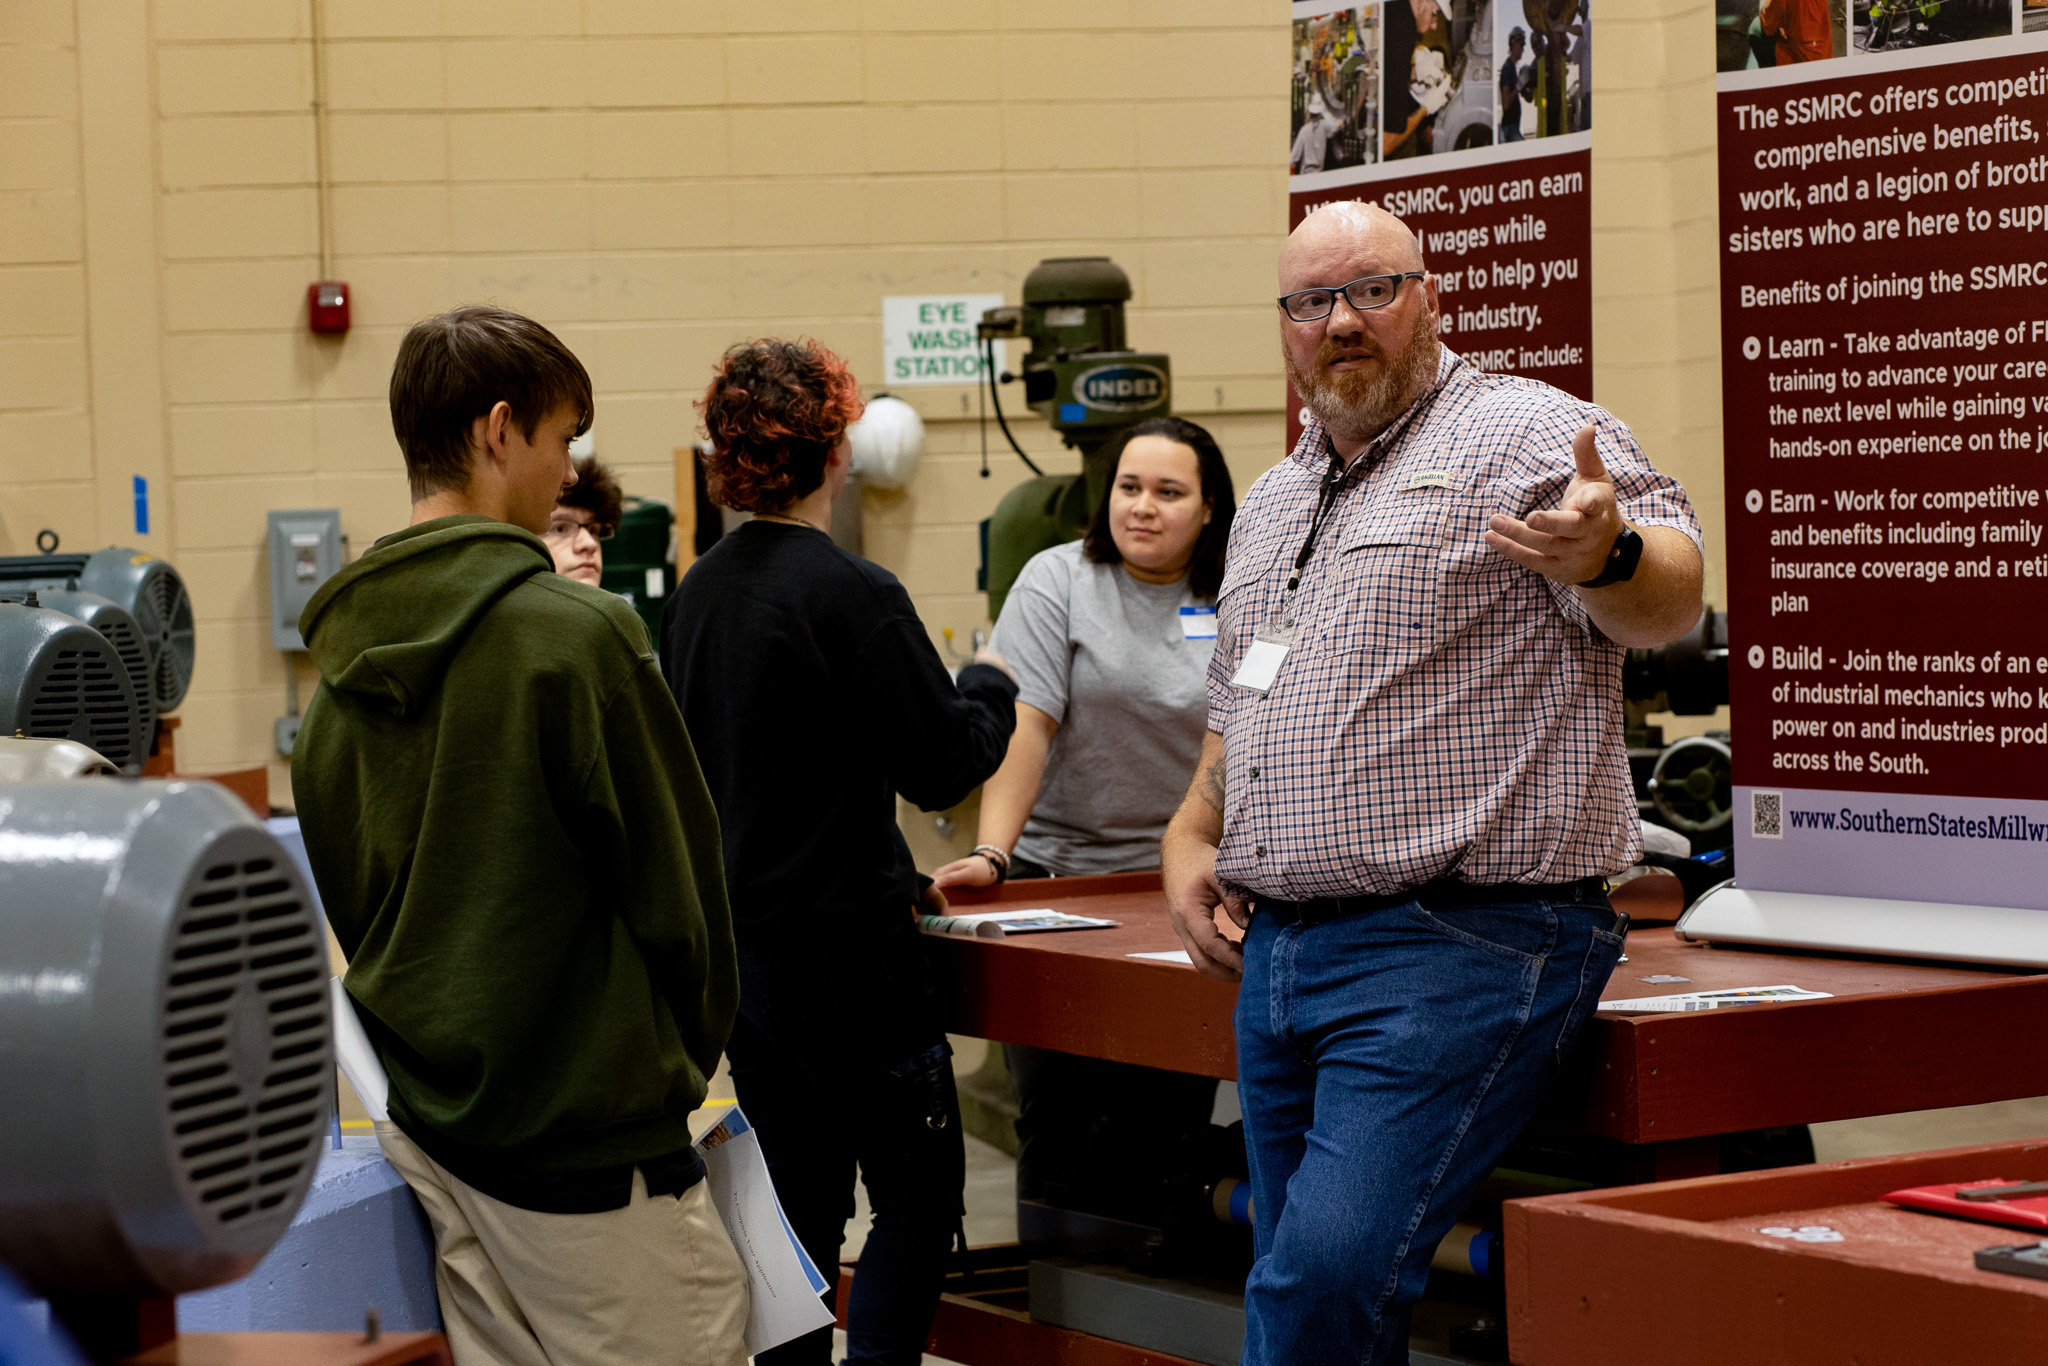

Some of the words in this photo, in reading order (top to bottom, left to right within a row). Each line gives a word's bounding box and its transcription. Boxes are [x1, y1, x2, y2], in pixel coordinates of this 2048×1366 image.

[1734, 105, 1778, 130] The
[1785, 92, 1862, 125] SSMRC
[1870, 86, 1938, 114] offers
[1946, 67, 2048, 105] competi
[1755, 127, 1926, 171] comprehensive
[1934, 114, 2039, 149] benefits,
[1383, 184, 1454, 217] SSMRC,
[1459, 185, 1493, 213] you
[1499, 179, 1533, 202] can
[1540, 172, 1582, 197] earn
[1740, 182, 1801, 211] work,
[1808, 176, 1848, 204] and
[1856, 180, 1868, 200] a
[1877, 167, 1947, 201] legion
[1955, 162, 1980, 189] of
[1428, 227, 1488, 255] wages
[1494, 214, 1546, 244] while
[1730, 226, 1803, 252] sisters
[1809, 219, 1855, 245] who
[1863, 219, 1900, 241] are
[1908, 211, 1959, 236] here
[1966, 207, 1991, 231] to
[1428, 270, 1462, 294] ner
[1468, 266, 1487, 289] to
[1493, 259, 1535, 289] help
[1541, 259, 1577, 288] you
[1741, 280, 1821, 307] Benefits
[1827, 277, 1847, 301] of
[1852, 272, 1922, 304] joining
[1930, 270, 1963, 293] the
[919, 302, 967, 324] EYE
[1459, 303, 1541, 331] industry.
[1769, 336, 1823, 359] Learn
[1844, 332, 1890, 353] Take
[1896, 327, 1999, 351] advantage
[2005, 321, 2025, 344] of
[1461, 348, 1516, 371] SSMRC
[1520, 344, 1582, 368] include:
[1088, 378, 1157, 398] INDEX
[1769, 368, 1836, 393] training
[1842, 369, 1861, 388] to
[1867, 365, 1947, 386] advance
[1953, 364, 1998, 387] your
[2004, 361, 2046, 379] care
[1769, 405, 1797, 425] the
[1803, 403, 1841, 423] next
[1848, 399, 1890, 421] level
[1897, 396, 1947, 419] while
[1953, 393, 2025, 421] gaining
[1770, 436, 1851, 458] hands-on
[1858, 431, 1962, 458] experience
[1969, 434, 1992, 450] on
[1999, 428, 2031, 449] the
[1771, 490, 1814, 512] Earn
[1835, 490, 1884, 511] Work
[1890, 488, 1917, 509] for
[1923, 484, 2039, 513] competitive
[1771, 525, 1802, 545] and
[1809, 522, 1882, 545] benefits
[1889, 521, 1975, 547] including
[1982, 519, 2042, 546] family
[1772, 557, 1856, 578] insurance
[1862, 562, 1948, 582] coverage
[1955, 556, 1990, 577] and
[1997, 561, 2007, 577] a
[2015, 554, 2047, 577] reti
[1772, 592, 1808, 616] plan
[1773, 645, 1822, 670] Build
[1843, 649, 1881, 670] Join
[1887, 651, 1917, 671] the
[1924, 651, 1975, 672] ranks
[1981, 651, 2001, 672] of
[2007, 657, 2030, 673] an
[1772, 682, 1790, 702] of
[1796, 682, 1878, 704] industrial
[1885, 685, 1984, 707] mechanics
[1991, 687, 2032, 708] who
[1773, 720, 1827, 739] power
[1833, 722, 1855, 737] on
[1861, 718, 1895, 739] and
[1902, 717, 1994, 742] industries
[2001, 723, 2047, 747] prod
[1773, 753, 1829, 770] across
[1834, 751, 1863, 771] the
[1870, 752, 1929, 774] South.
[1790, 807, 2048, 842] www.SouthernStatesMillw
[755, 1259, 777, 1299] Application
